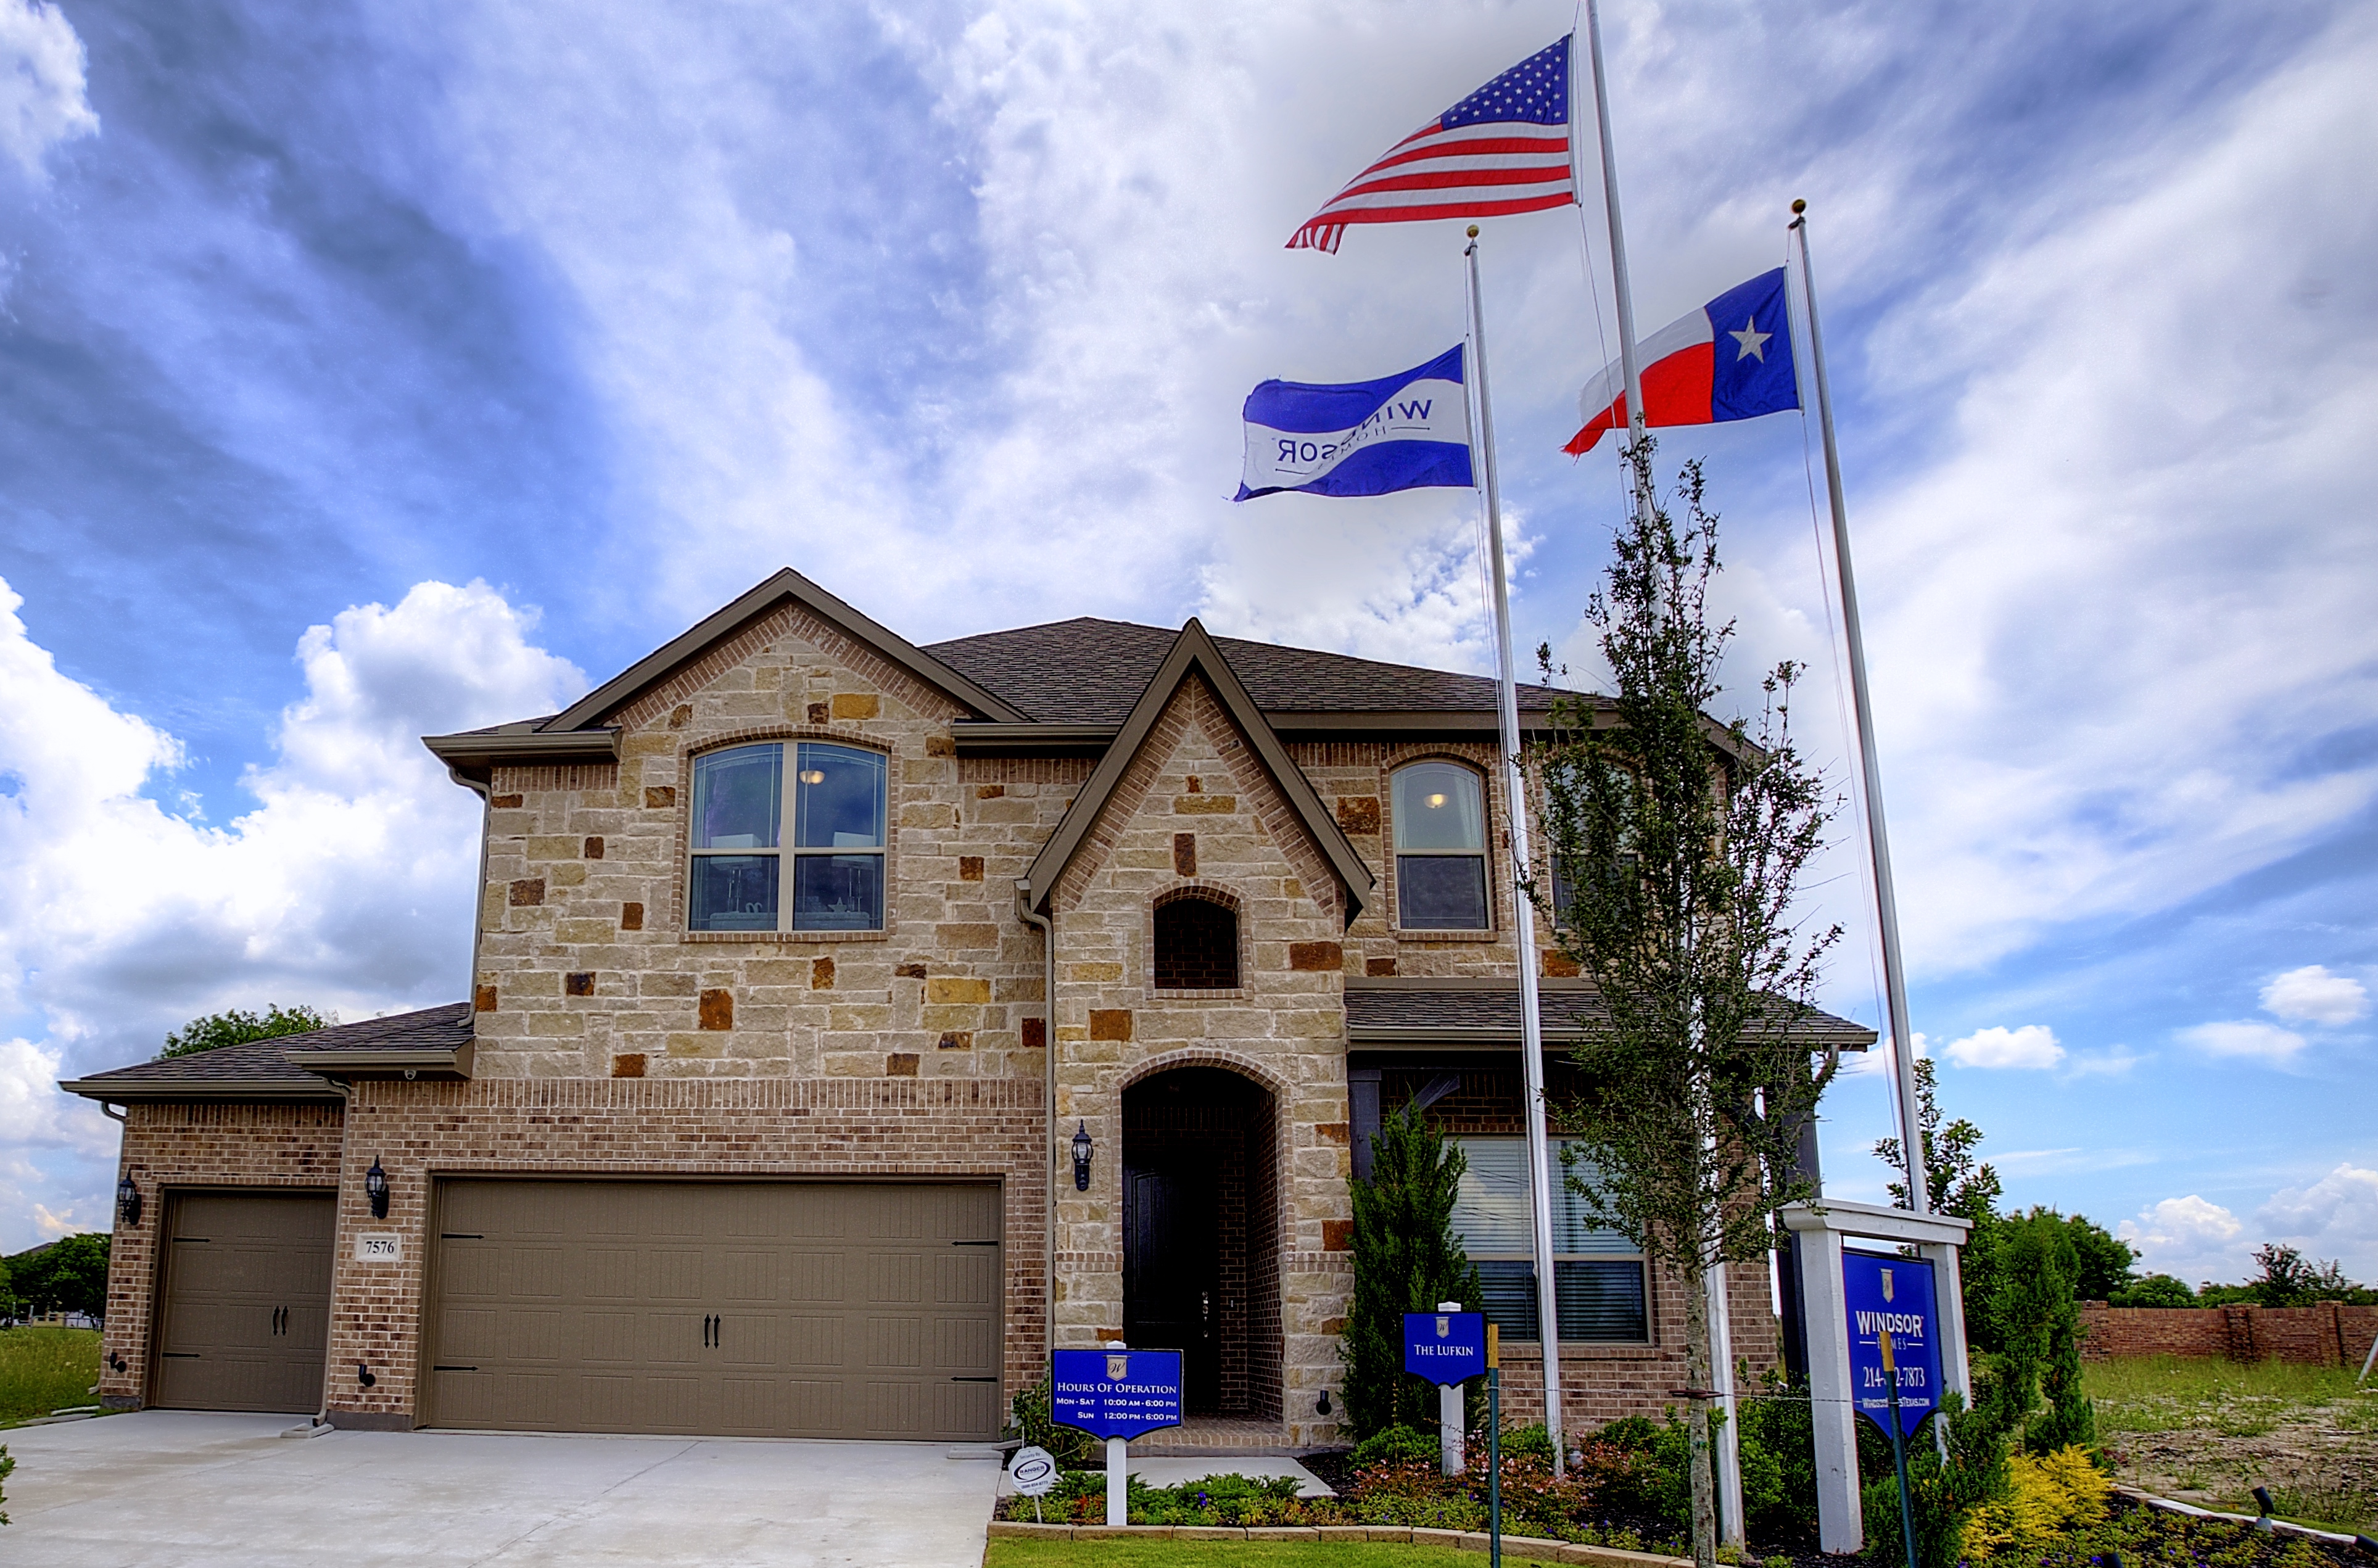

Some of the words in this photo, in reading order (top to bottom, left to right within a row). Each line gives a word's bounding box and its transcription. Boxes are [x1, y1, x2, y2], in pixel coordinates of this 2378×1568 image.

[366, 1241, 395, 1253] 7576
[1856, 1311, 1923, 1337] WINDSOR
[1877, 1337, 1907, 1350] HMES
[1414, 1344, 1434, 1355] THE
[1437, 1345, 1473, 1356] LUFKIN
[1863, 1366, 1925, 1387] 214-2-7873
[1057, 1382, 1094, 1392] HOURS
[1097, 1383, 1113, 1392] OF
[1115, 1383, 1176, 1393] OPERATION
